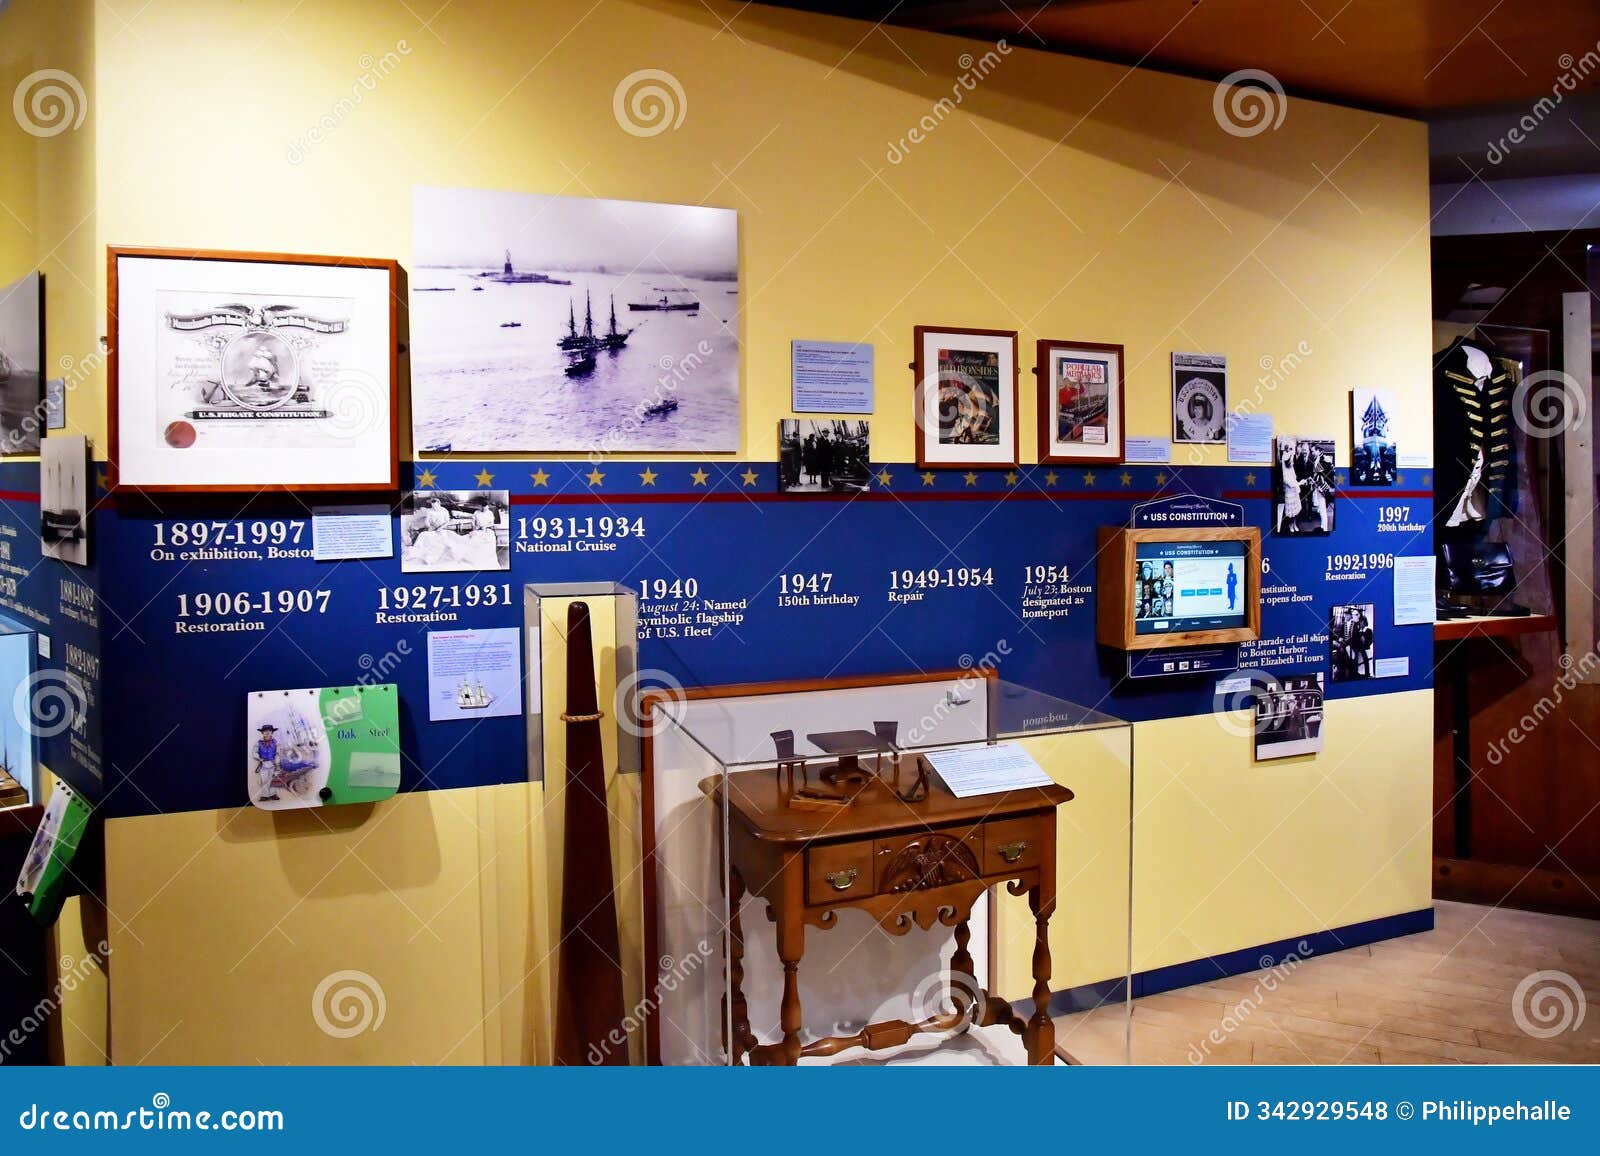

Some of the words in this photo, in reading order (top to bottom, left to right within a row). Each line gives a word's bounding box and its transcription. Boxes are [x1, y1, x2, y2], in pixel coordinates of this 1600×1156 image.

[1150, 513, 1167, 521] USS
[1169, 512, 1228, 521] CONSTITUTION
[1378, 506, 1410, 523] 1997
[153, 520, 305, 546] 1897-1997
[517, 516, 646, 539] 1931-1934
[1377, 523, 1397, 532] 200th
[1398, 523, 1427, 534] birthday
[150, 548, 175, 561] On
[179, 547, 263, 561] exhibition,
[515, 541, 572, 553] National
[575, 541, 617, 552] Cruise
[1326, 553, 1394, 571] 1992-1996
[889, 567, 994, 590] 1949-1954
[1024, 565, 1069, 585] 1954
[1325, 572, 1366, 582] Restoration
[639, 578, 698, 600] 1940
[779, 572, 833, 595] 1947
[1261, 583, 1297, 594] nstitution
[378, 583, 512, 611] 1927-1931
[888, 590, 925, 604] Repair
[1021, 585, 1043, 599] July
[1044, 585, 1058, 596] 23:
[1060, 584, 1092, 595] Boston
[178, 589, 332, 617] 1906-1907
[638, 600, 679, 615] August
[682, 600, 700, 612] 24:
[704, 599, 747, 611] Named
[778, 595, 811, 607] 150th
[813, 594, 860, 607] birthday
[1022, 595, 1072, 608] designated
[1074, 596, 1085, 605] as
[1267, 595, 1290, 607] opens
[1291, 593, 1313, 602] doors
[375, 611, 458, 625] Restoration
[637, 613, 693, 629] symbolic
[695, 612, 744, 627] flagship
[1022, 608, 1069, 620] homeport
[175, 618, 265, 634] Restoration
[638, 627, 652, 640] of
[656, 626, 680, 638] U.S.
[684, 626, 713, 637] fleet
[1258, 636, 1284, 649] parade
[1286, 634, 1294, 644] of
[1296, 634, 1309, 642] tall
[1310, 633, 1329, 644] ships
[1250, 648, 1277, 657] Boston
[1240, 660, 1259, 668] ueen
[1260, 655, 1295, 667] Elizabeth
[1296, 654, 1303, 663] II
[1304, 654, 1324, 662] tours
[337, 729, 357, 740] Oak
